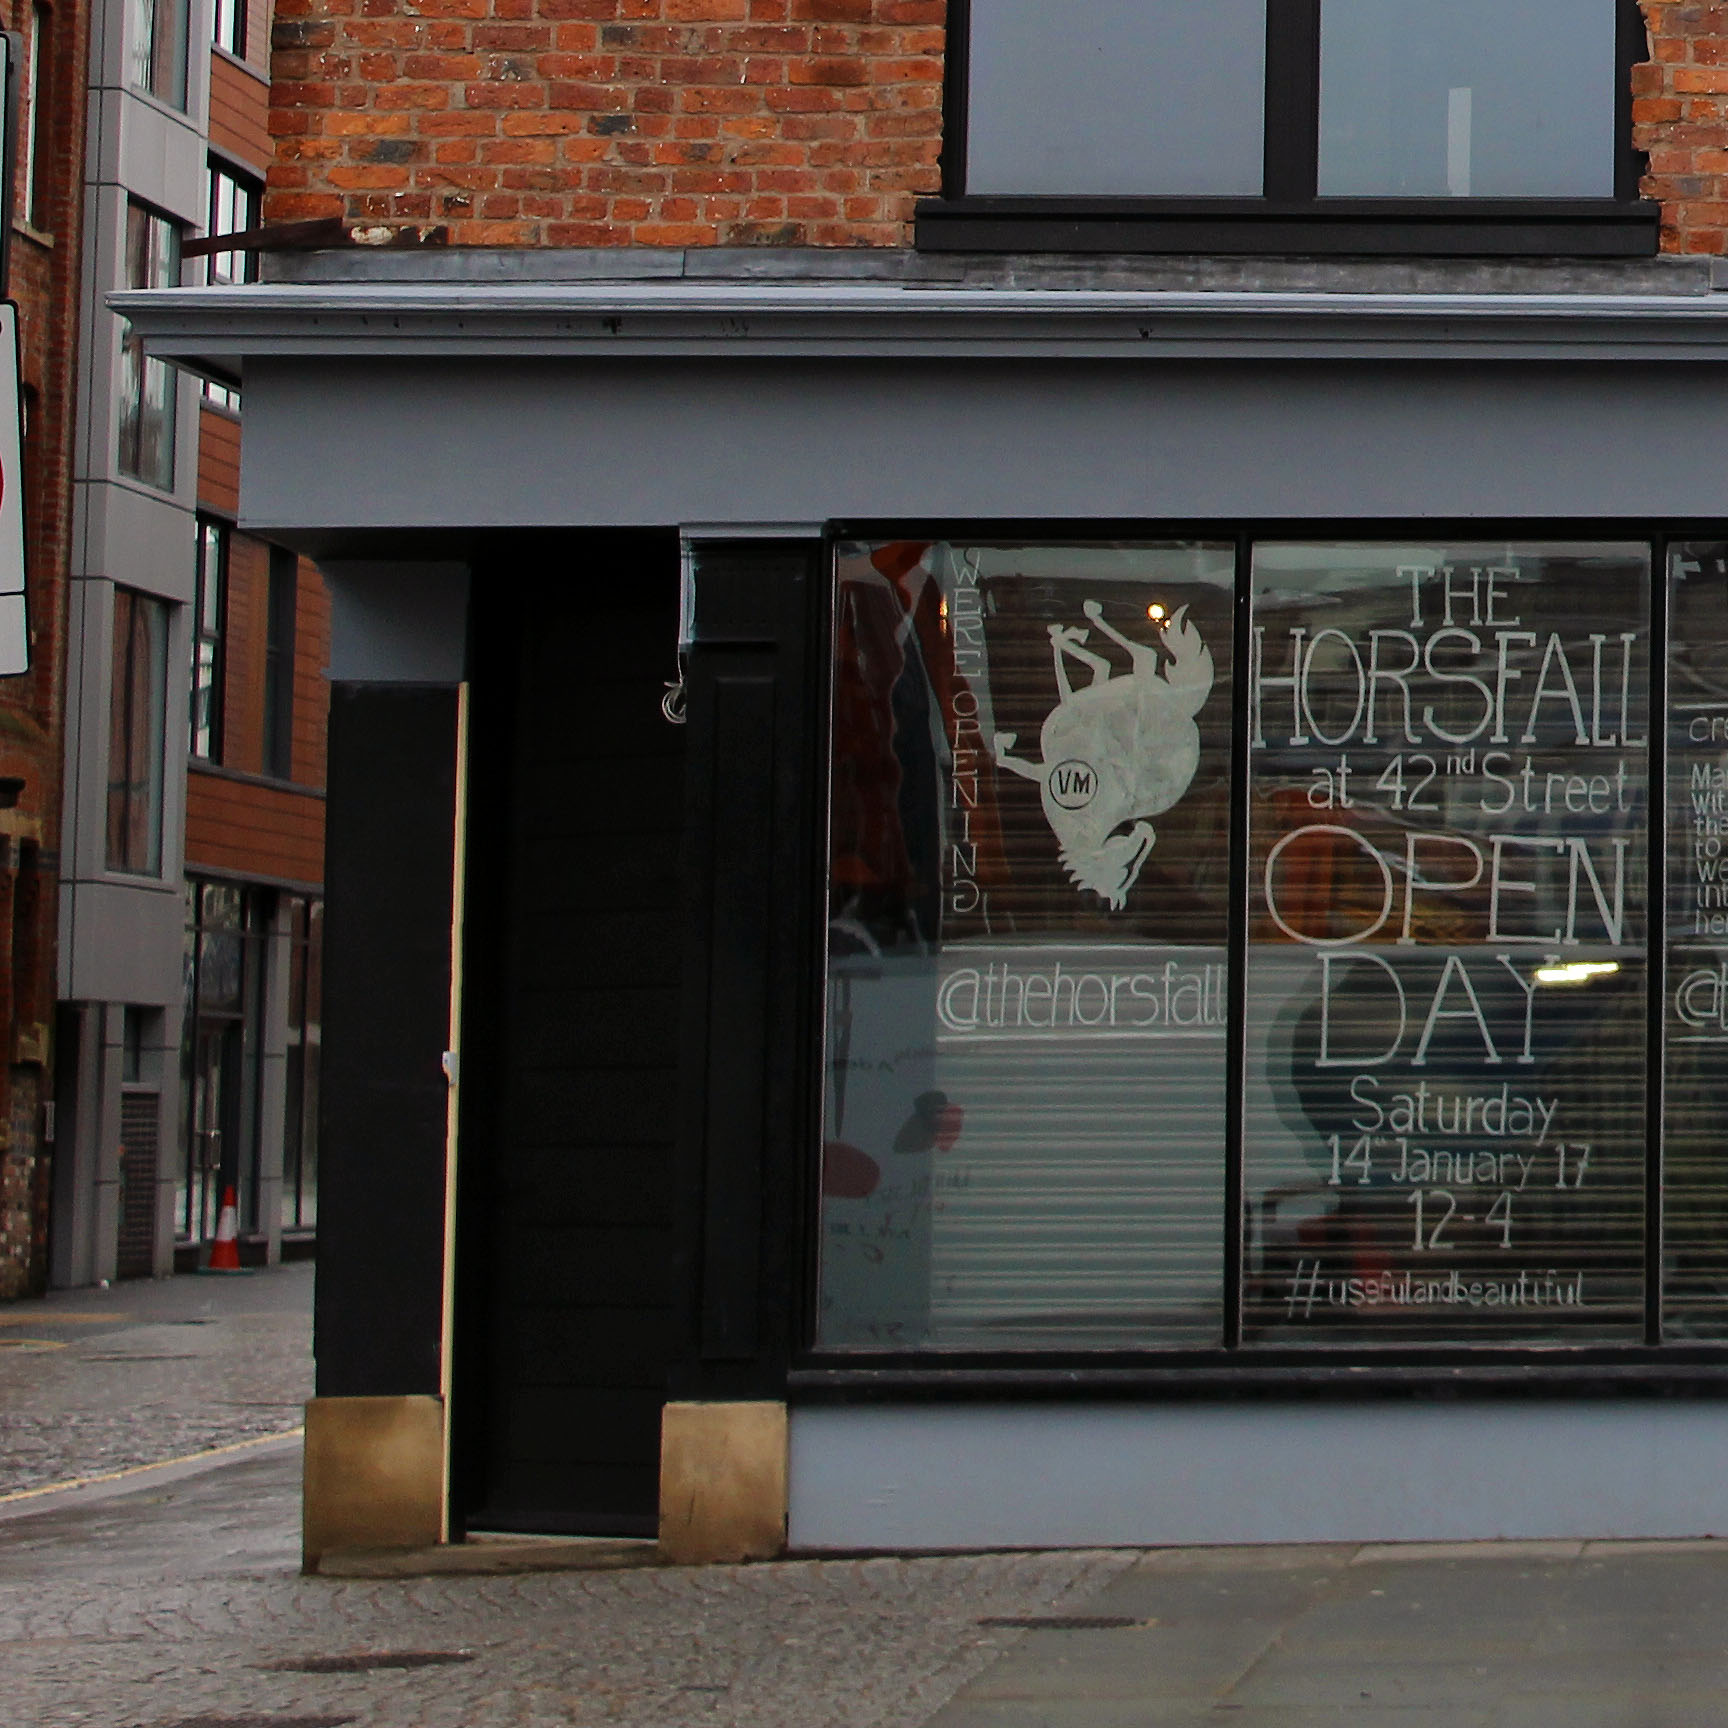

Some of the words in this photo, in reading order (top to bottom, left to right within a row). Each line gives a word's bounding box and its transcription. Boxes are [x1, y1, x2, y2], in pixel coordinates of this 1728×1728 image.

[1396, 564, 1521, 628] THE
[1251, 625, 1649, 749] HORSFALL
[1058, 769, 1091, 794] VM
[1307, 754, 1354, 810] at
[1376, 748, 1475, 812] 42nd
[1480, 752, 1632, 814] Street
[1694, 837, 1721, 859] to
[1266, 824, 1630, 946] OPEN
[937, 961, 1226, 1031] @thehorsfall
[1315, 951, 1560, 1067] DAY
[1350, 1074, 1558, 1147] Saturday
[1391, 1137, 1535, 1192] January
[1554, 1143, 1590, 1189] 17
[1284, 1260, 1583, 1319] #usefulandbeautiful
